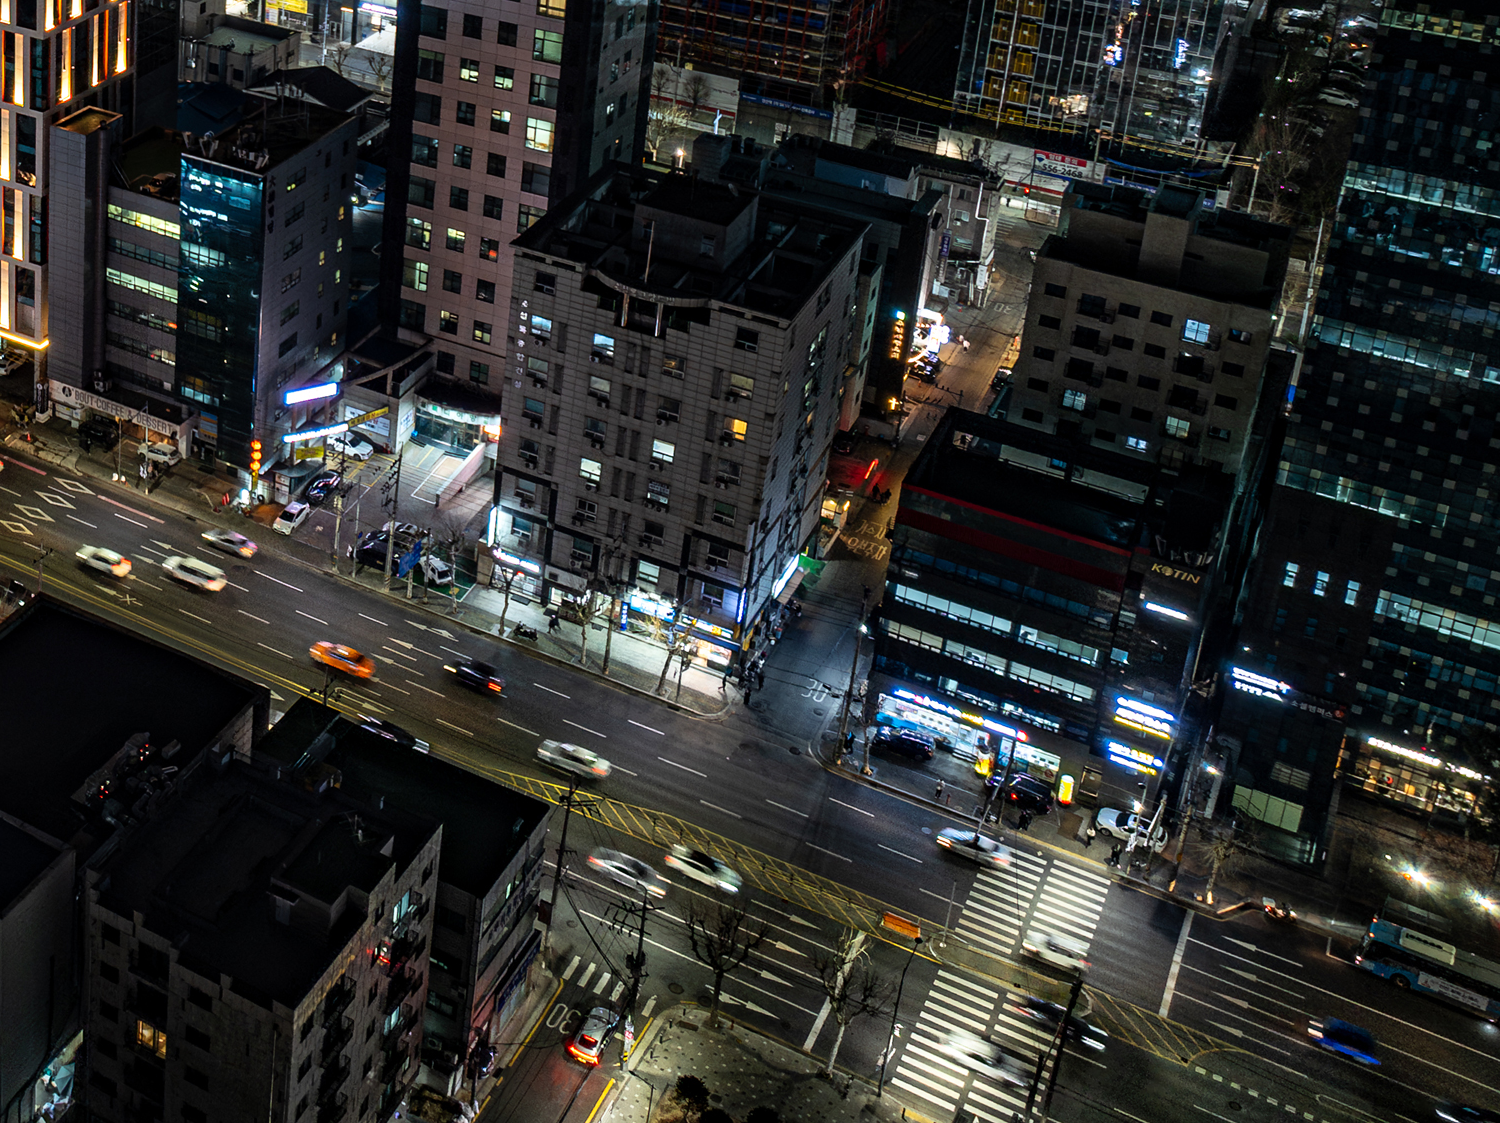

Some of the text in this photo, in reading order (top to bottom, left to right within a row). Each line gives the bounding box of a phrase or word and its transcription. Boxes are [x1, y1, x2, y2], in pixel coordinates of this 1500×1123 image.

[137, 413, 174, 434] DESSERT
[1151, 562, 1201, 585] KOTIN
[801, 677, 829, 703] 30
[545, 1002, 583, 1035] 30
